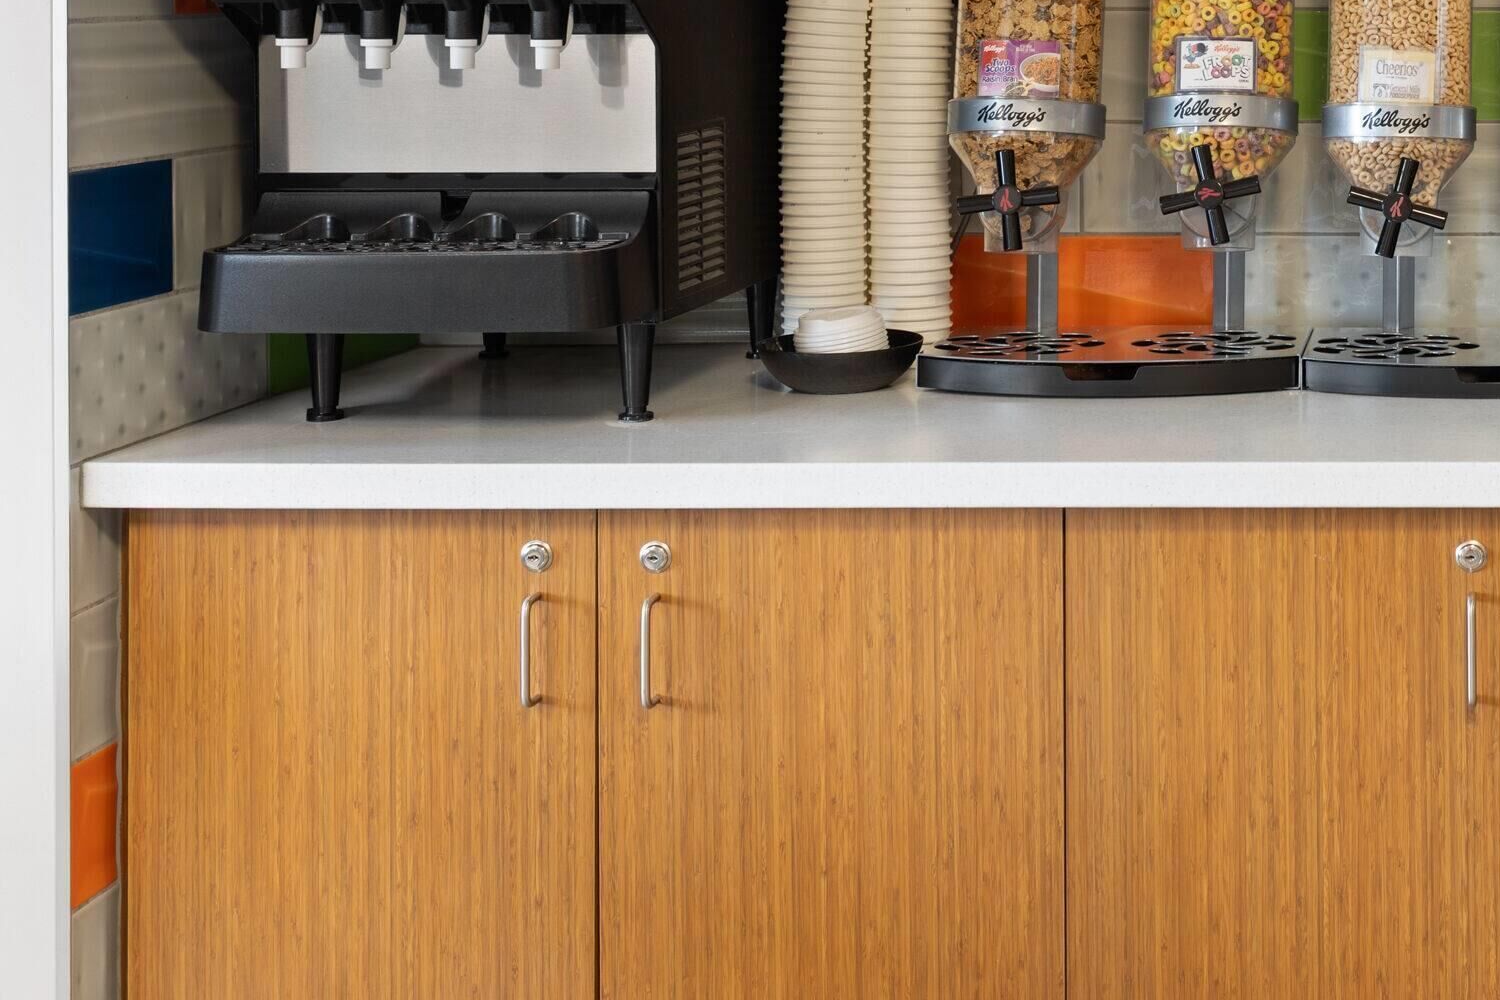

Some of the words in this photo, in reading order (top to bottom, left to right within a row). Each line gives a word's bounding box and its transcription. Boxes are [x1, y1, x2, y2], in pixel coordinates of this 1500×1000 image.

[985, 64, 1016, 73] Scoops
[992, 58, 1009, 66] Two
[1202, 54, 1251, 69] FROOT
[1376, 59, 1418, 77] Cheerios
[983, 75, 1001, 83] Raisin
[1202, 65, 1250, 81] LOOPS
[977, 102, 1047, 128] Kellogg's
[1173, 97, 1242, 123] Kellogg's
[1362, 107, 1431, 134] Kellogg's
